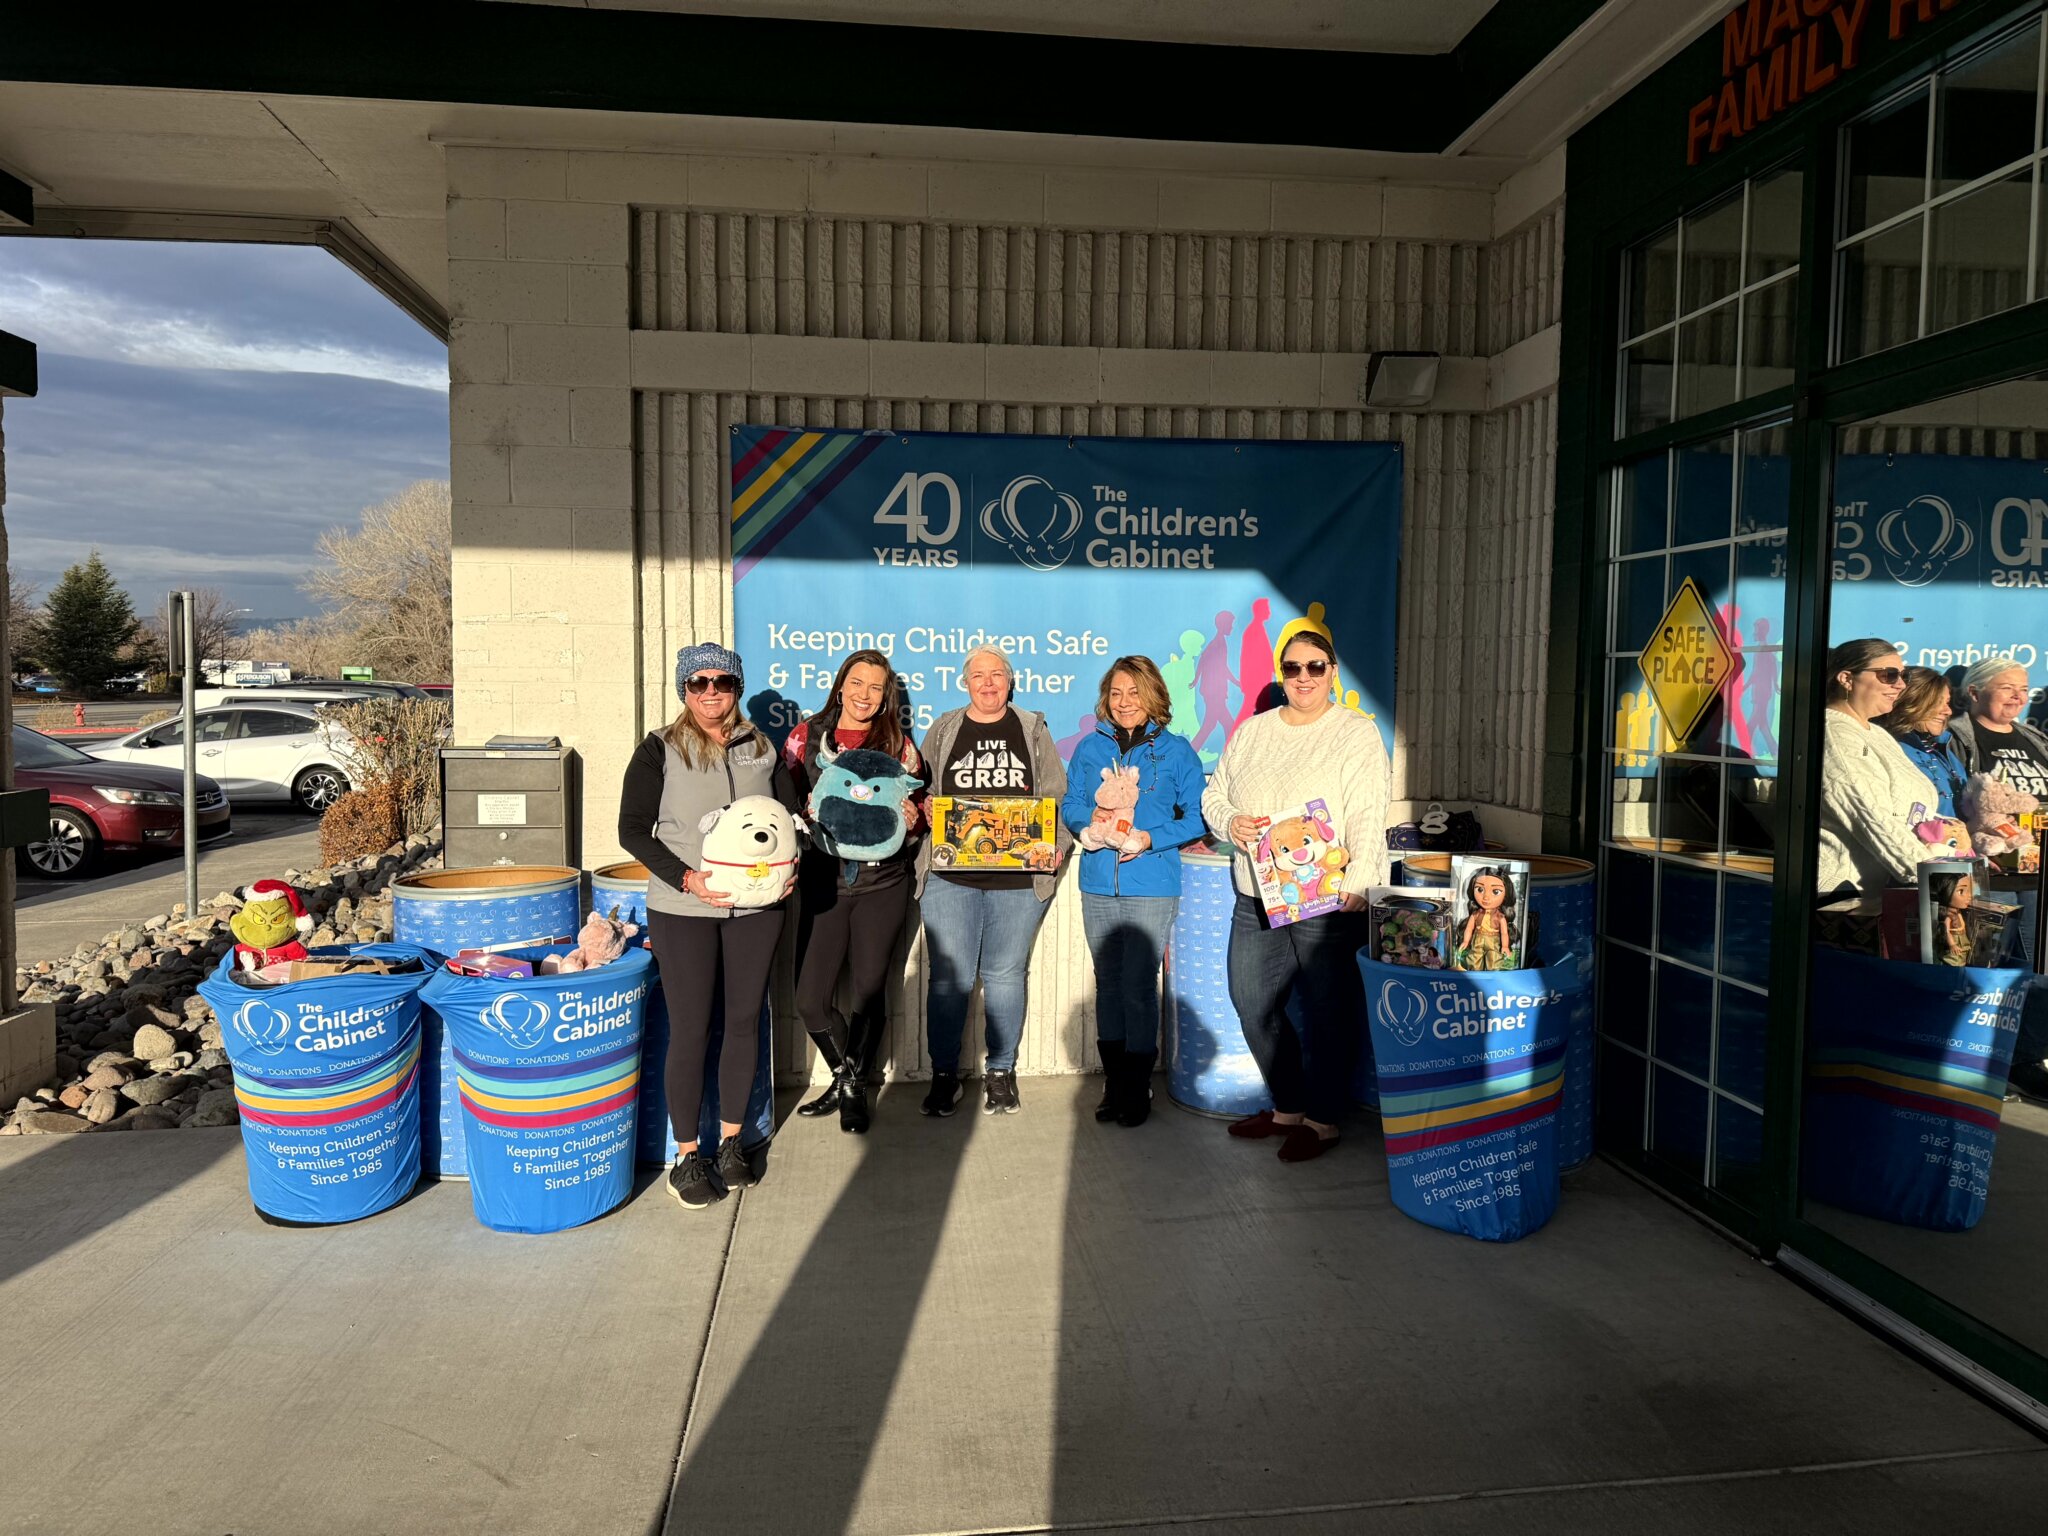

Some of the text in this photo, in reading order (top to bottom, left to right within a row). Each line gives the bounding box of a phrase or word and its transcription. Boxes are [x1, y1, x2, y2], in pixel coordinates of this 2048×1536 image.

[1686, 0, 1872, 166] FAMILY
[1092, 485, 1127, 502] The
[873, 472, 961, 545] 40
[1095, 505, 1259, 537] Children's
[873, 547, 959, 568] YEARS
[1086, 538, 1215, 570] Cabinet
[768, 624, 1109, 658] Keeping Children Safe
[1663, 626, 1706, 653] SAFE
[768, 663, 789, 689] &
[977, 740, 1007, 751] LIVE
[737, 758, 769, 766] GREATER
[954, 769, 1025, 788] GR8R
[556, 992, 582, 1003] The
[1430, 981, 1457, 992] The
[297, 1003, 323, 1014] The
[559, 981, 647, 1022] Children's
[295, 1020, 386, 1052] Cabinet
[553, 1009, 632, 1043] Cabinet
[1432, 1011, 1527, 1040] Cabinet
[268, 1066, 322, 1076] DONATIONS
[329, 1051, 382, 1071] DONATIONS
[468, 1038, 622, 1065] DONATIONS DONATIONS DONATIONS
[1409, 1057, 1456, 1071] DONATIONS
[1462, 1047, 1516, 1065] DONATIONS
[277, 1128, 327, 1137] DONATIONS
[334, 1111, 384, 1133] DONATIONS
[478, 1110, 624, 1139] DONATIONS DONATIONS DONATIONS
[268, 1141, 320, 1157] Keeping
[324, 1131, 382, 1153] Children
[506, 1119, 633, 1160] Keeping Children Safe
[1417, 1143, 1461, 1163] DONATIONS
[1466, 1129, 1517, 1150] DONATIONS
[278, 1158, 286, 1169] &
[288, 1156, 345, 1171] Families
[513, 1137, 629, 1174] & Families Together
[1412, 1138, 1538, 1188] Keeping Children Safe
[310, 1160, 383, 1186] Since 1985
[544, 1161, 611, 1190] Since 1985
[1423, 1191, 1432, 1206] &
[1433, 1179, 1484, 1202] Families
[1455, 1183, 1522, 1213] Since 1985
